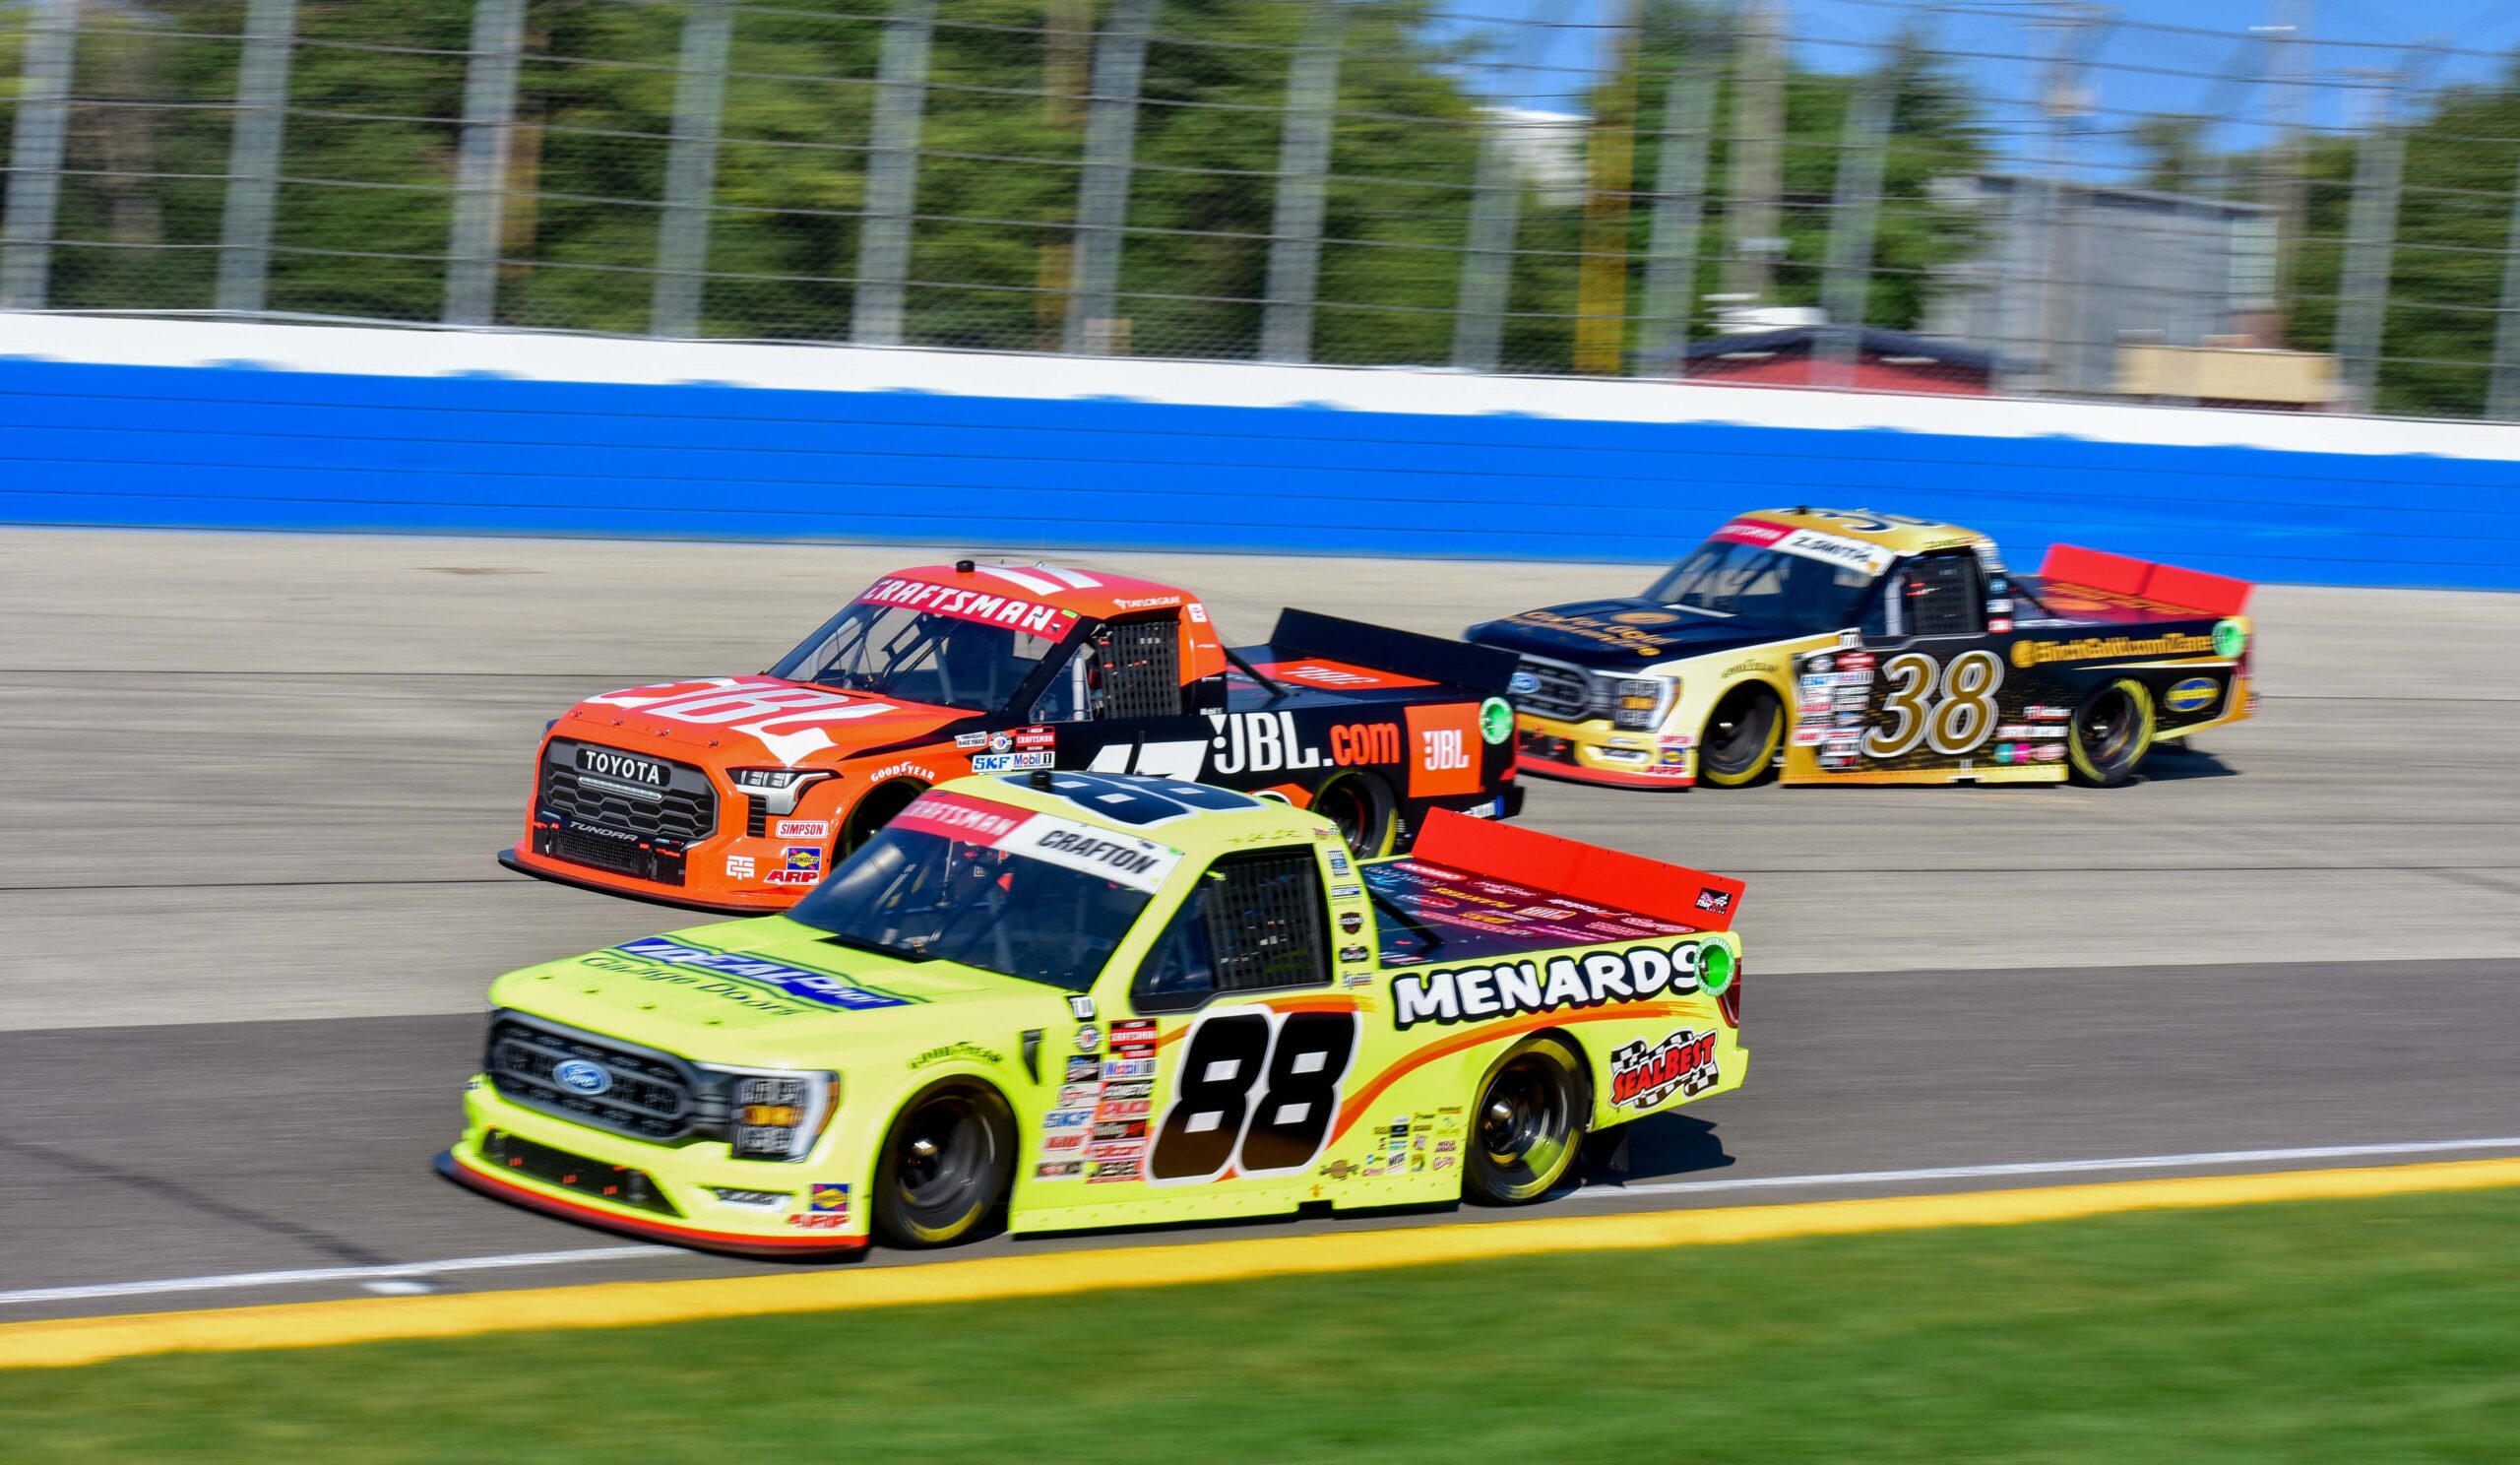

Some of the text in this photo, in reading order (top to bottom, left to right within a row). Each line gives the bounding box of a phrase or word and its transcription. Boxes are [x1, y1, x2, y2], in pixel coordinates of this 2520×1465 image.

[862, 579, 1056, 631] CRAFTSMAN
[1861, 652, 2003, 757] 38
[974, 756, 1011, 770] SKF
[1013, 752, 1040, 766] Mobil
[1422, 730, 1470, 771] JBL
[586, 751, 661, 785] TOYOTA
[870, 761, 936, 783] GOODYEAR
[569, 821, 639, 843] TUNDRA
[780, 823, 824, 836] SIMPSON
[900, 799, 1021, 836] CRAFTSMAN
[788, 856, 819, 864] SUNOCO
[1037, 829, 1161, 875] CRAFTON
[766, 870, 820, 884] ARP
[1393, 943, 1702, 1027] MENARDS
[1611, 1032, 1717, 1107] SEALBEST
[1149, 1007, 1359, 1183] 88
[1043, 1111, 1094, 1128] SKF
